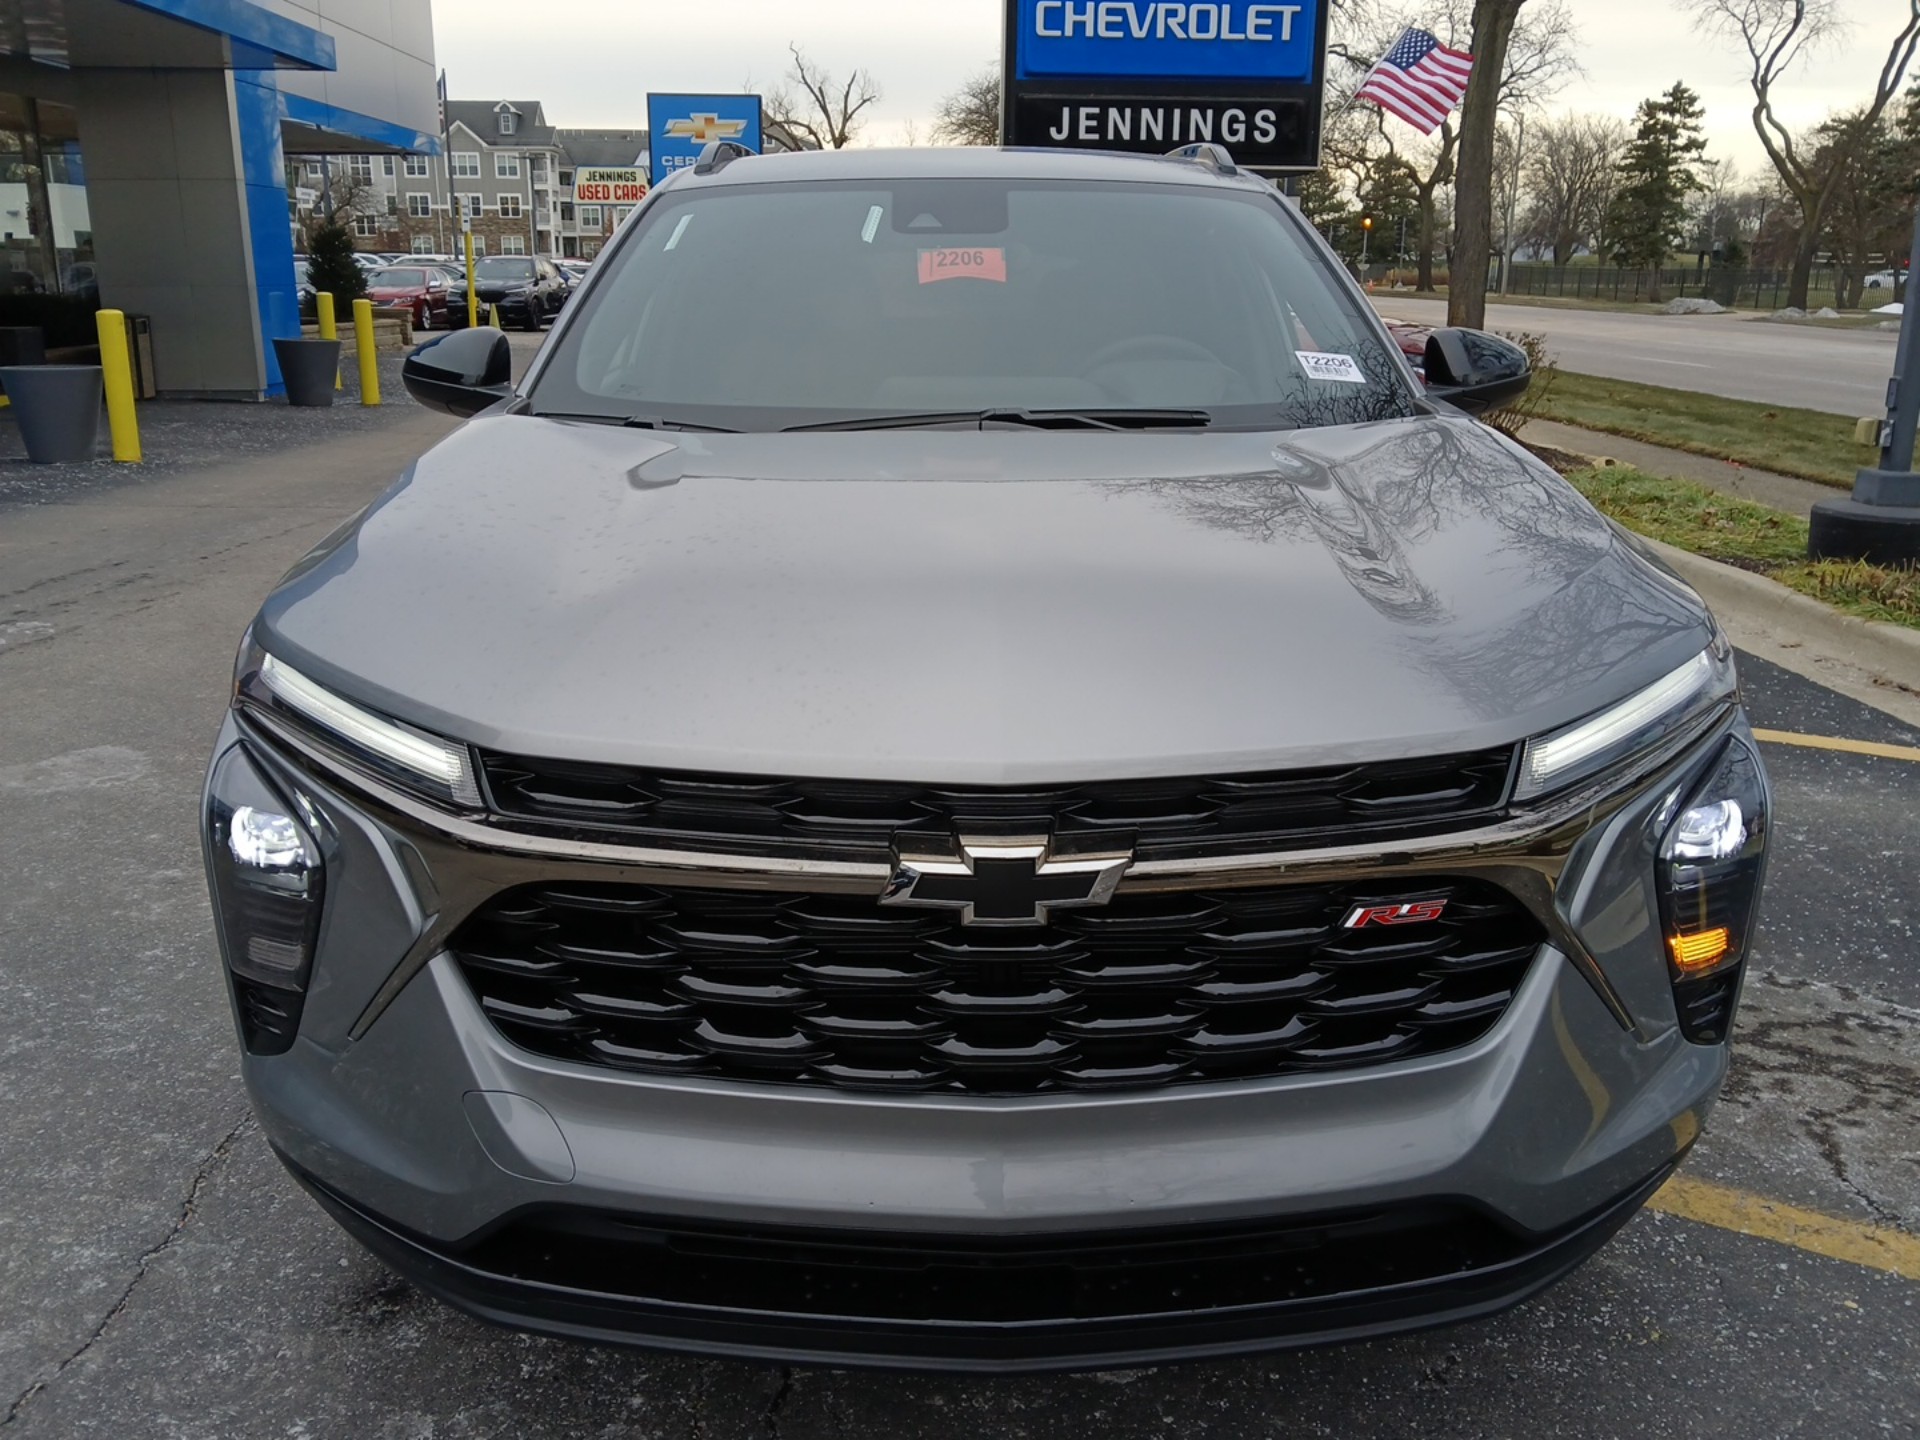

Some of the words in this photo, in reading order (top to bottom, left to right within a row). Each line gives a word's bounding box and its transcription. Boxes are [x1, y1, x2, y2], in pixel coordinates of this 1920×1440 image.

[1036, 1, 1301, 40] CHEVROLET
[1050, 107, 1277, 143] JENNINGS
[661, 155, 701, 166] CER
[585, 170, 637, 182] JENNINGS
[578, 184, 610, 200] USED
[614, 184, 646, 200] CARS
[937, 251, 985, 267] 2206
[1301, 355, 1352, 368] T2206
[1343, 899, 1448, 928] RS
